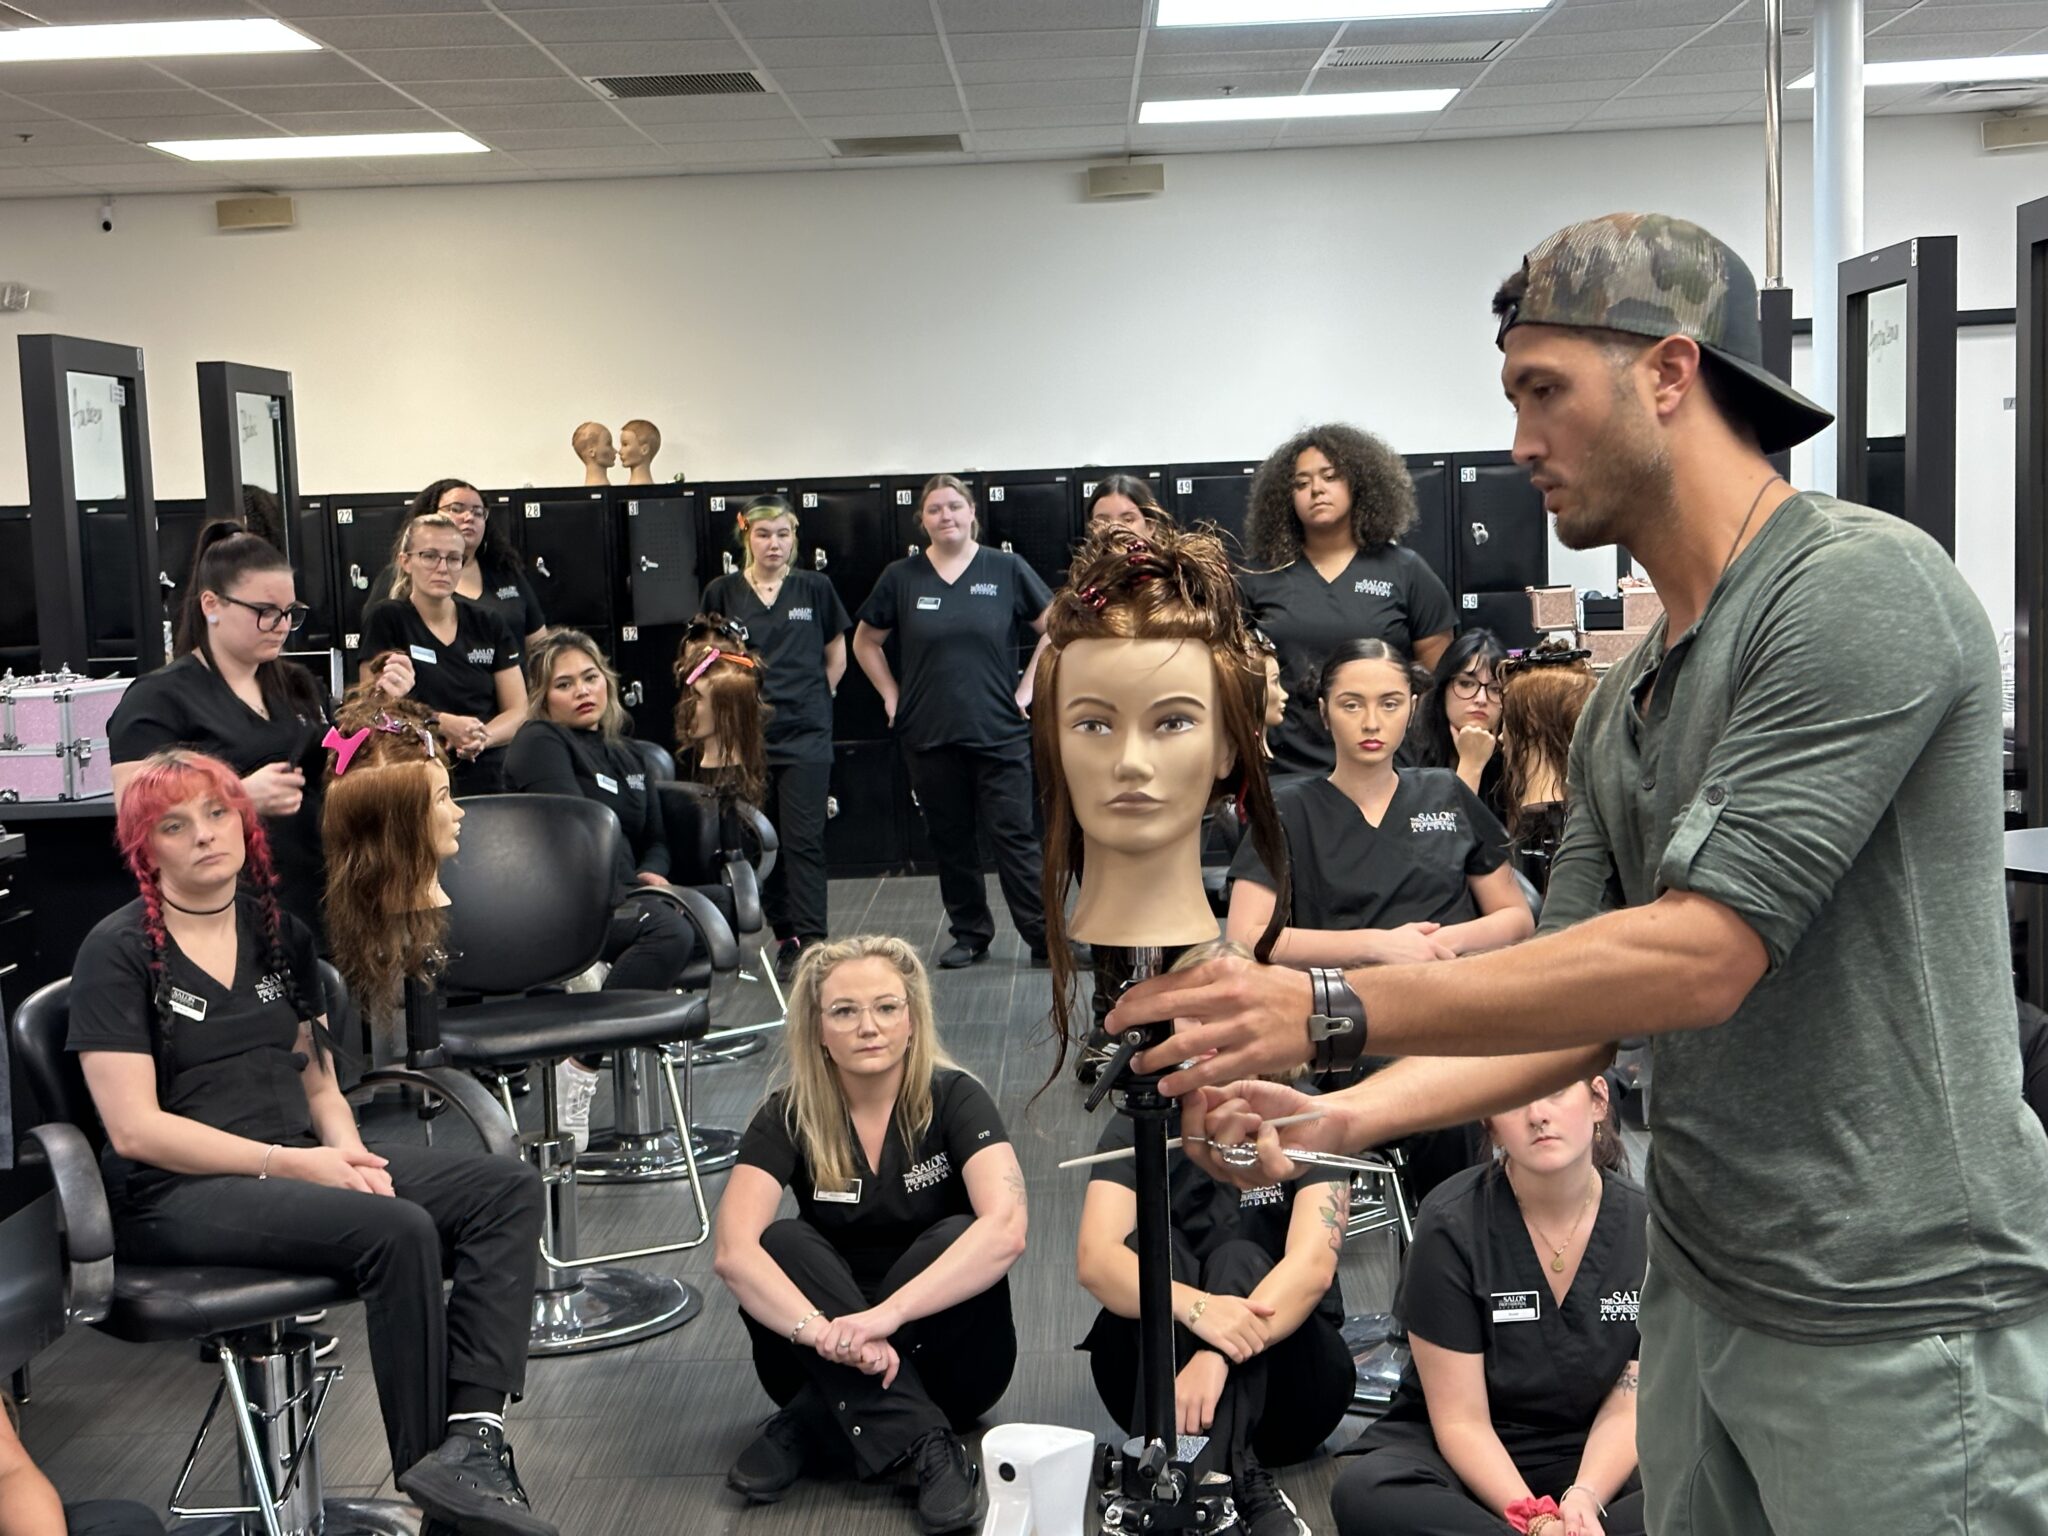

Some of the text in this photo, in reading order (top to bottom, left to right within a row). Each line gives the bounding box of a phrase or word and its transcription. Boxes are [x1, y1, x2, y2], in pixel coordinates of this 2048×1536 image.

[1462, 469, 1475, 481] 58
[1178, 481, 1191, 493] 49
[898, 491, 911, 504] 40
[990, 487, 1003, 500] 43
[712, 498, 725, 510] 34
[804, 494, 816, 507] 37
[527, 504, 539, 517] 28
[629, 502, 638, 514] 31
[339, 510, 352, 523] 22
[1463, 595, 1476, 608] 59
[624, 628, 637, 640] 32
[346, 635, 359, 647] 23
[1418, 811, 1455, 822] SALON
[911, 1152, 948, 1176] SALON
[1612, 1290, 1640, 1304] SAL
[1600, 1304, 1639, 1314] PROFESS
[1600, 1313, 1637, 1322] ACAD
